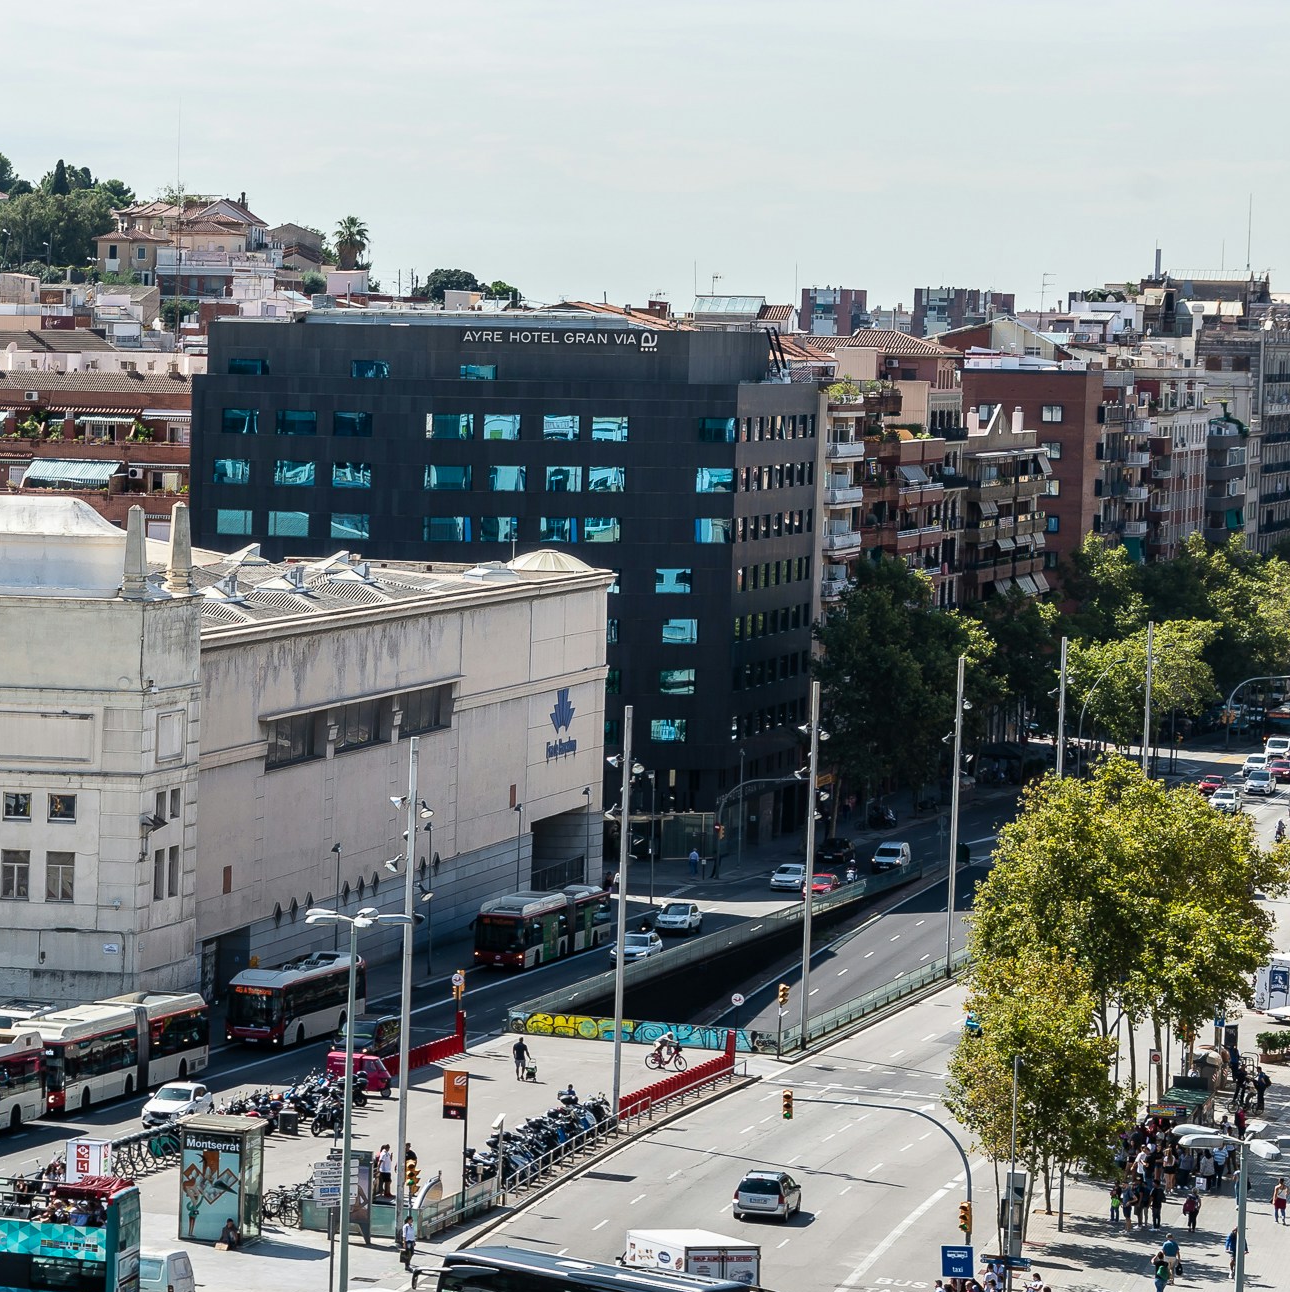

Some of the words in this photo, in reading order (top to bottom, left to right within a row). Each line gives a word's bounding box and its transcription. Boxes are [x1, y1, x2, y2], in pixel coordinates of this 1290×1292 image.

[463, 331, 503, 342] AYRE
[510, 331, 559, 343] HOTEL
[563, 332, 608, 344] GRAN
[614, 333, 637, 345] VIA
[186, 1137, 240, 1152] Montserrat
[78, 1161, 88, 1171] L1
[952, 1265, 964, 1273] taxi
[874, 1277, 930, 1289] BUS
